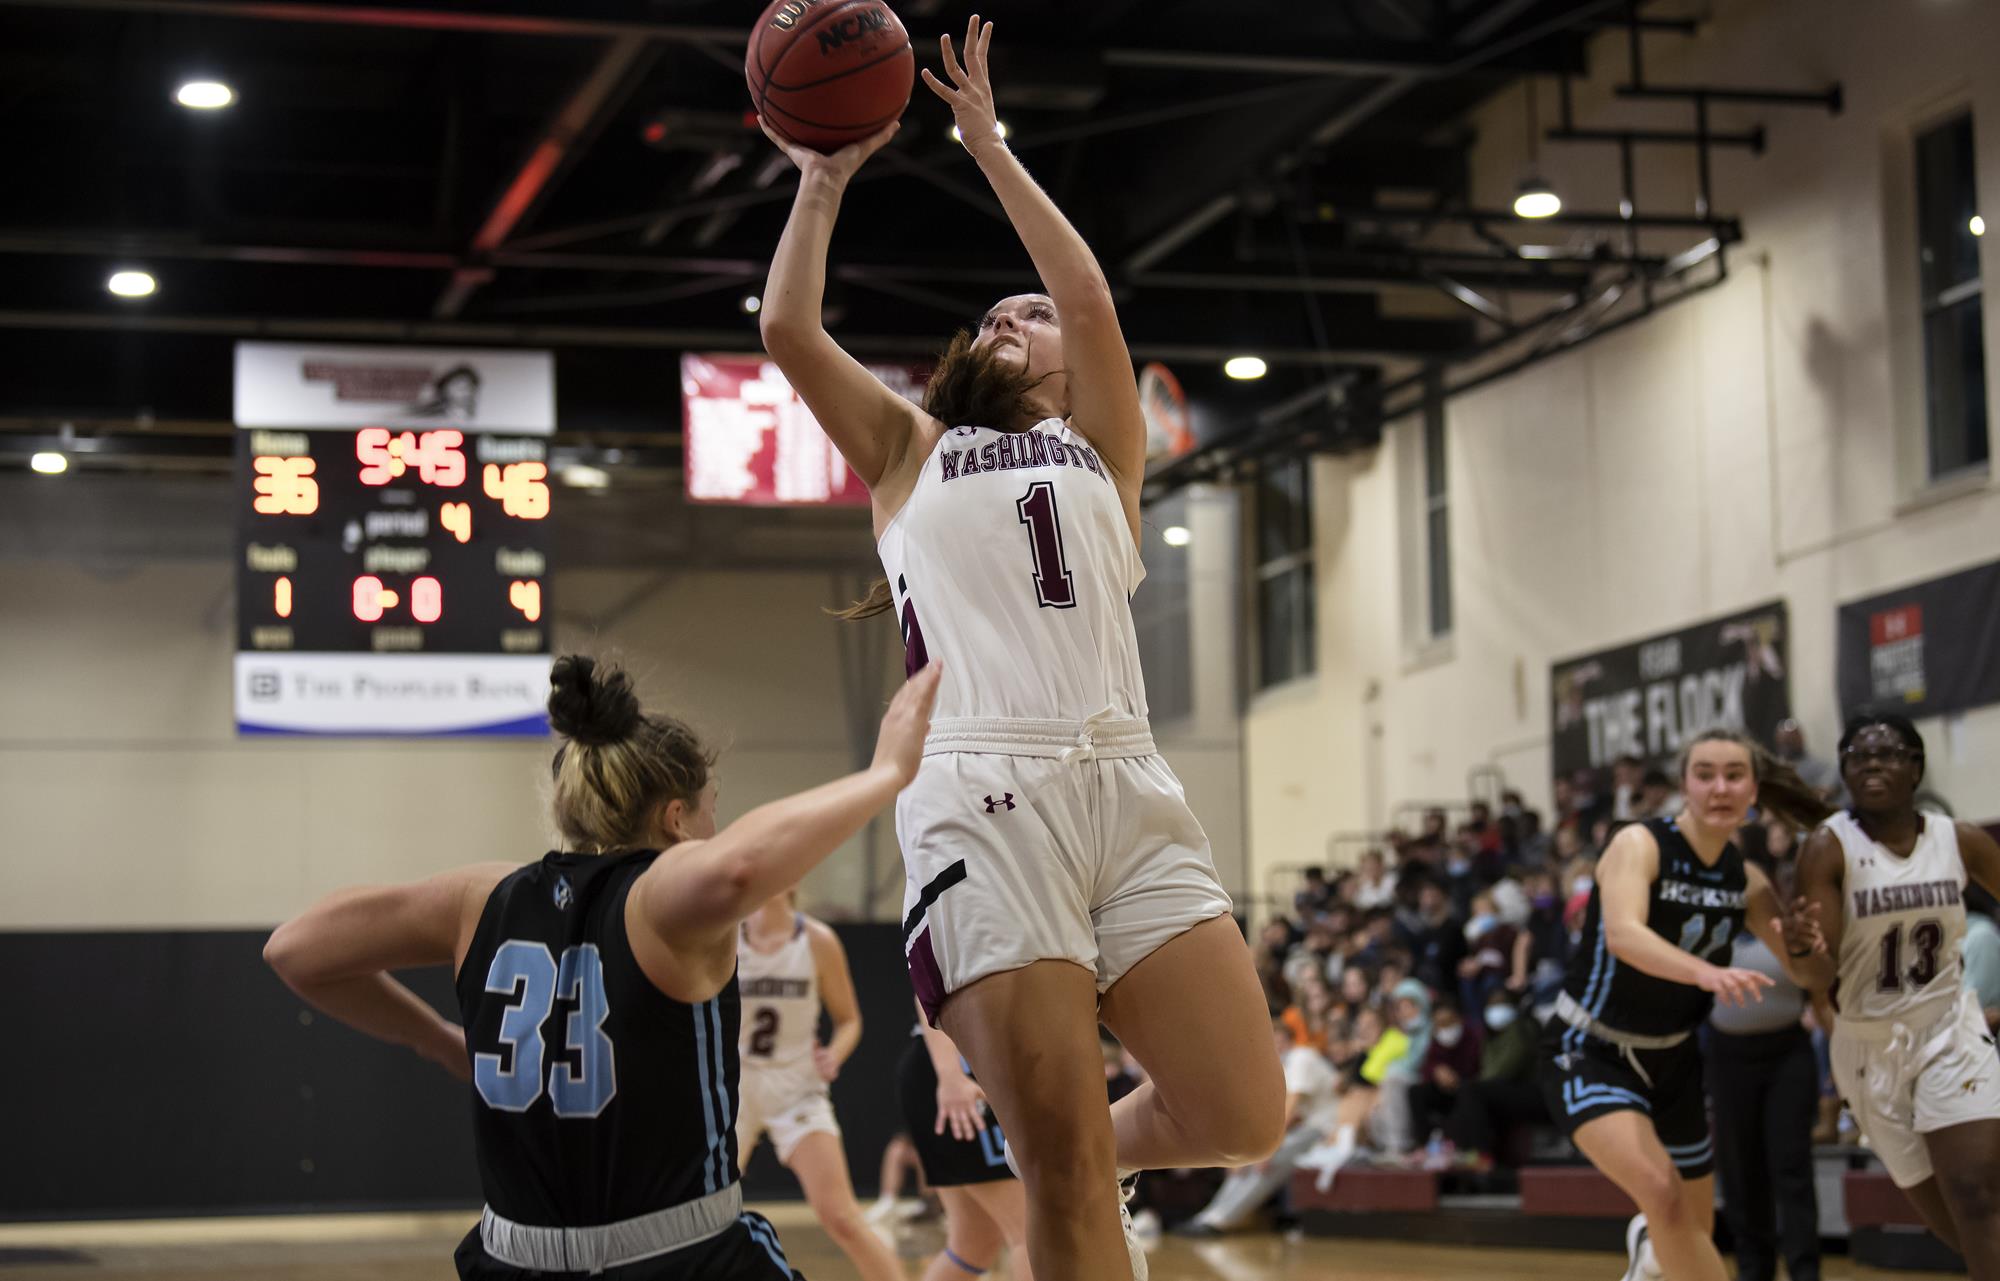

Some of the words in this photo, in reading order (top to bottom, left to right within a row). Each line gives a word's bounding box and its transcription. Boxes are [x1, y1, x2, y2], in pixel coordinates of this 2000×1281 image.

[816, 8, 894, 56] NCAA
[253, 456, 319, 515] 36
[356, 428, 466, 487] 5:45
[440, 502, 471, 543] 4
[1016, 481, 1076, 608] 1
[275, 576, 292, 617] 1
[1584, 688, 1645, 768] THE
[1645, 660, 1746, 756] FLOCK
[1876, 917, 1944, 993] 13
[475, 939, 616, 1118] 33
[747, 1005, 780, 1058] 2
